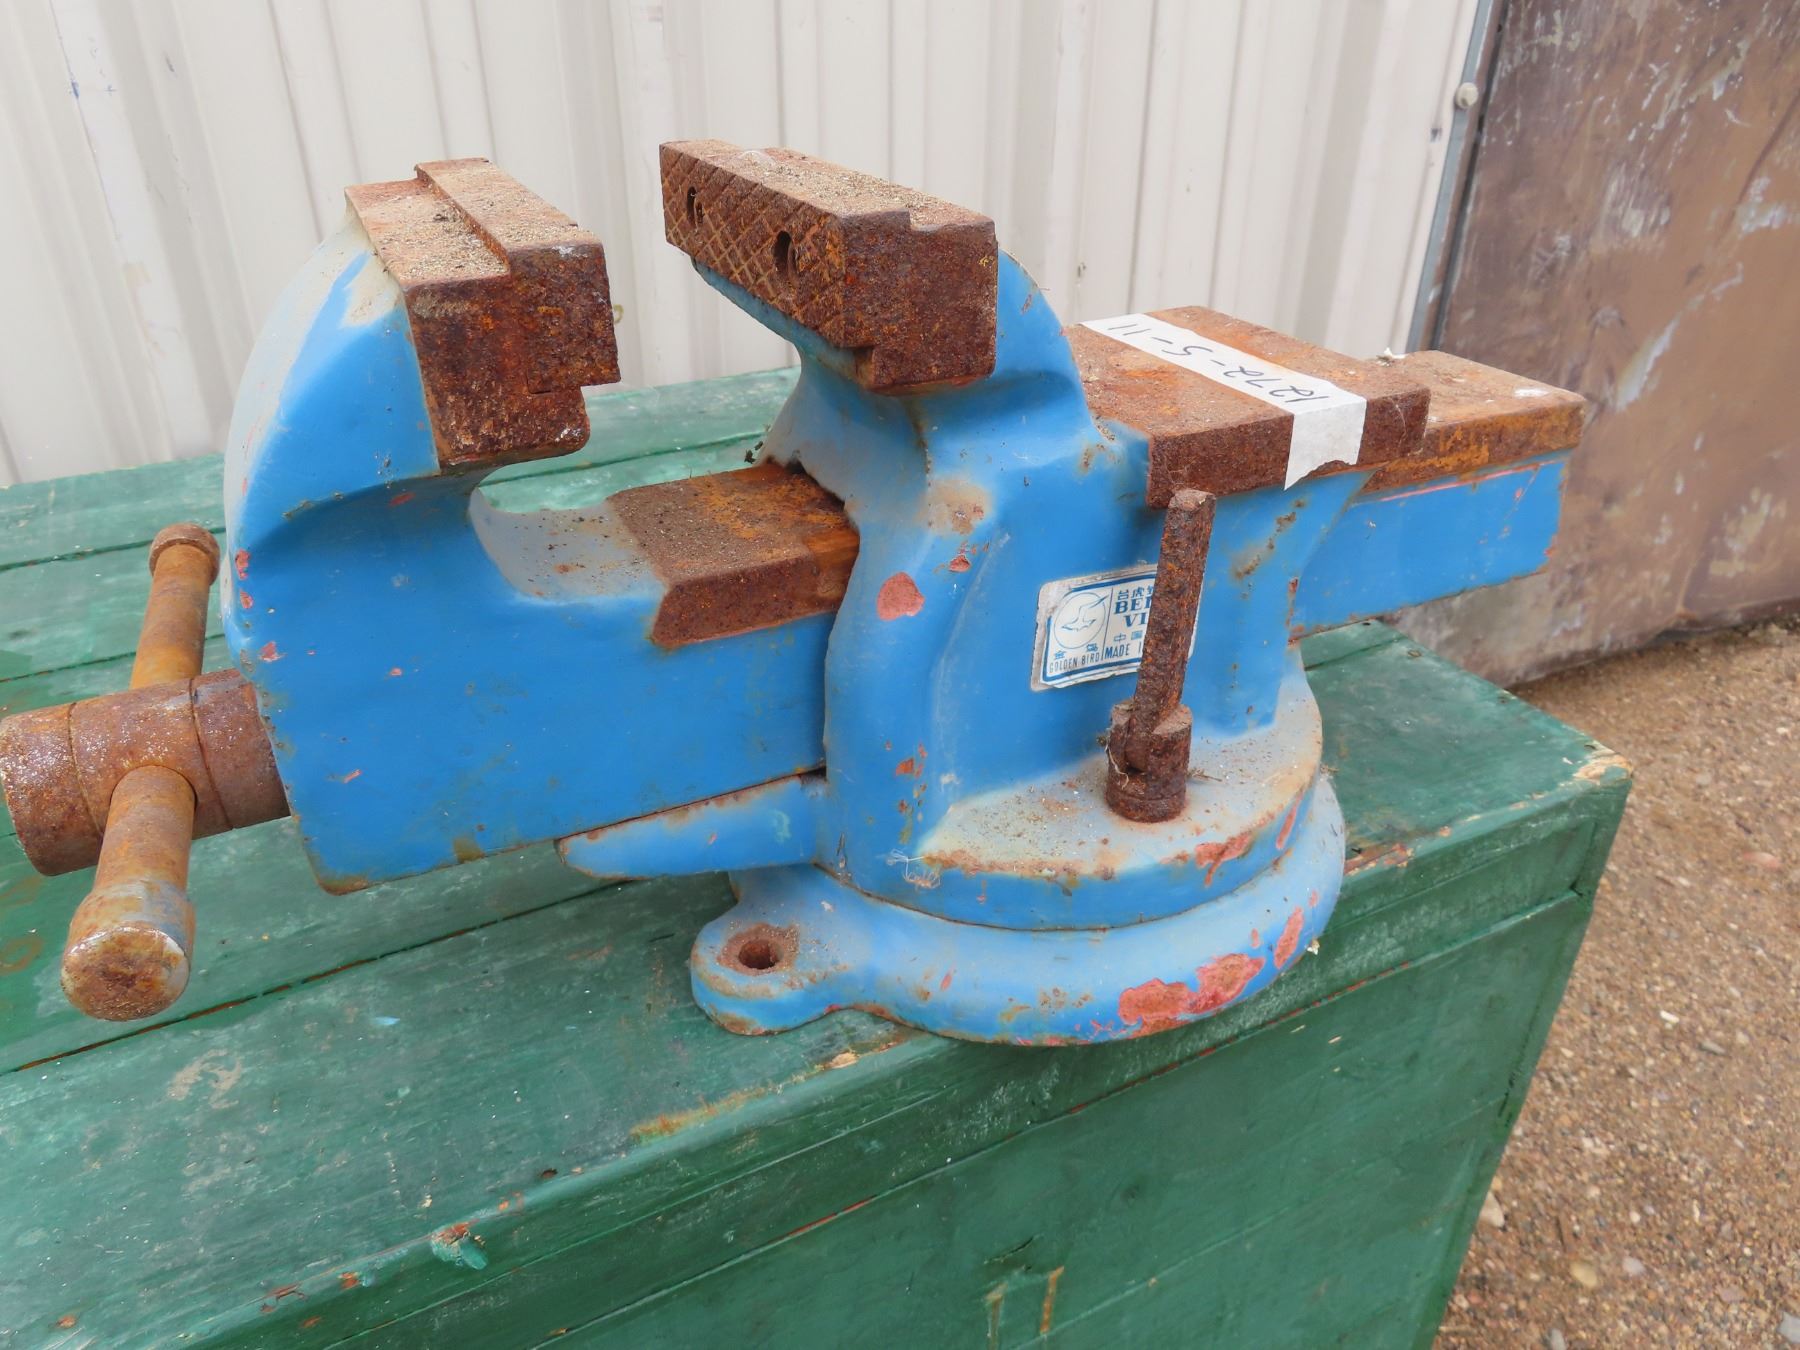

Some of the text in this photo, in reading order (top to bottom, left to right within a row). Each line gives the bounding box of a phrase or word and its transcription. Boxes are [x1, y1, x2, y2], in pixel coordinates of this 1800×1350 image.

[1104, 643, 1131, 659] MADE
[1049, 652, 1100, 673] GOLDEN BIRD
